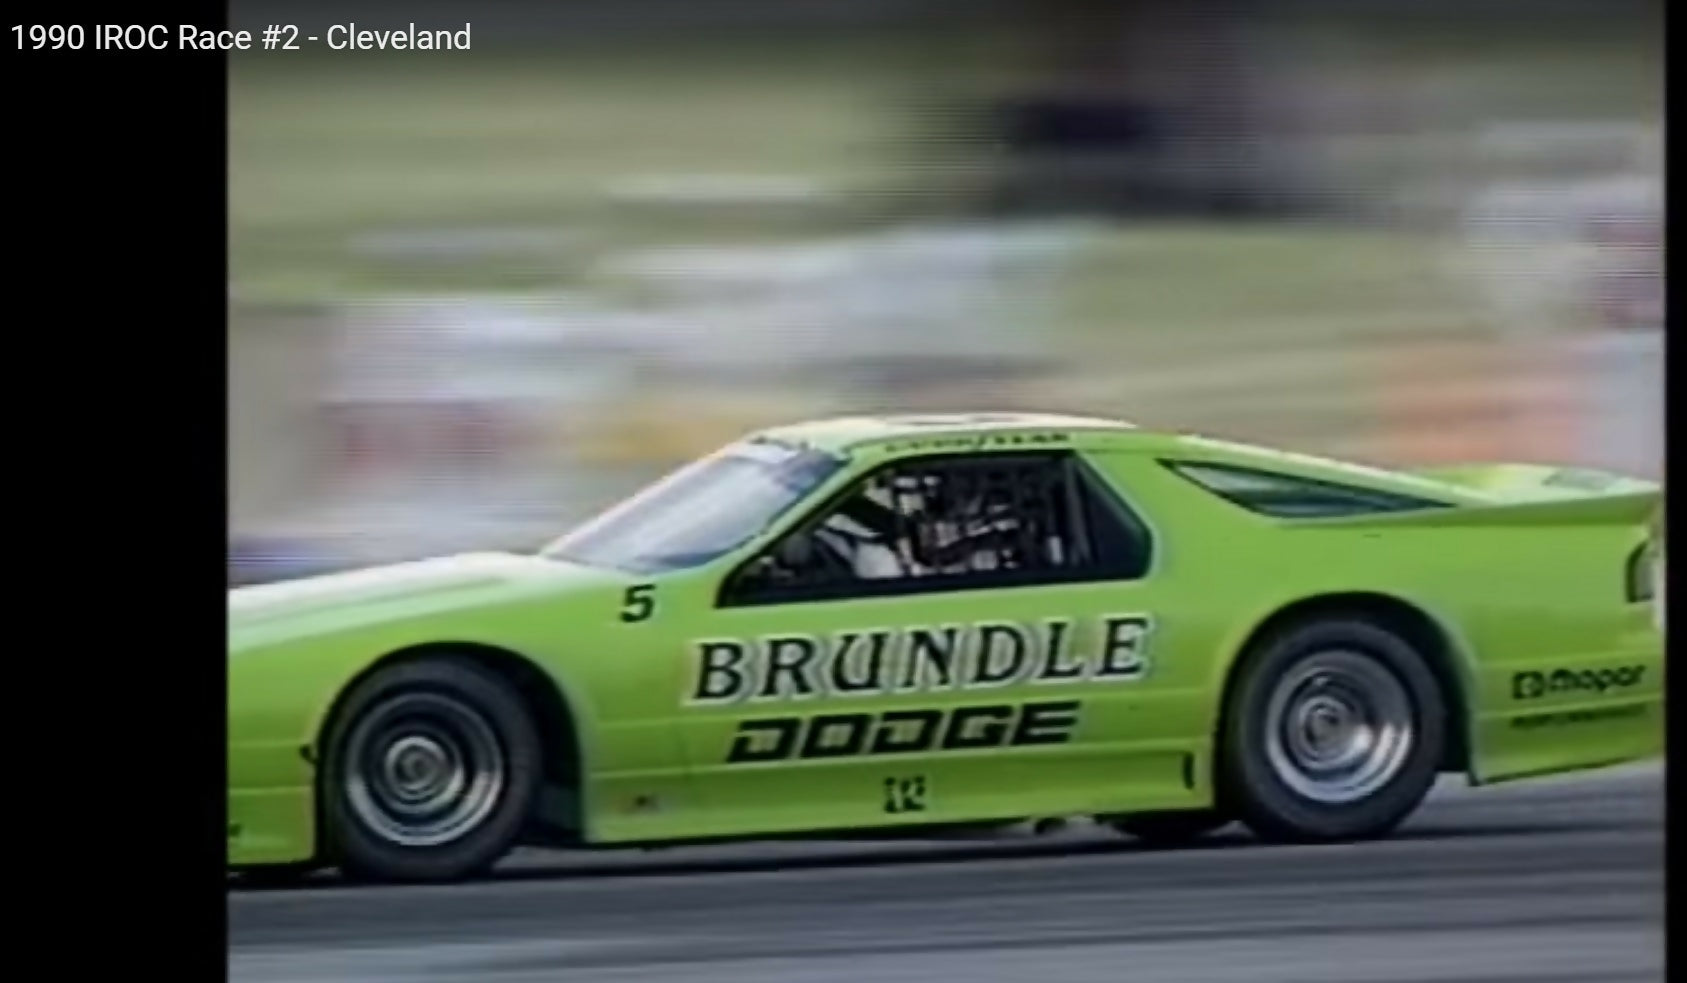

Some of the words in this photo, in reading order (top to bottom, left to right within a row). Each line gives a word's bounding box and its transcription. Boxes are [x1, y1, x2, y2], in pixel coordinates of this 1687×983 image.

[619, 584, 655, 622] 5
[690, 616, 1151, 702] BRUNDLE
[725, 700, 1082, 764] DODGE
